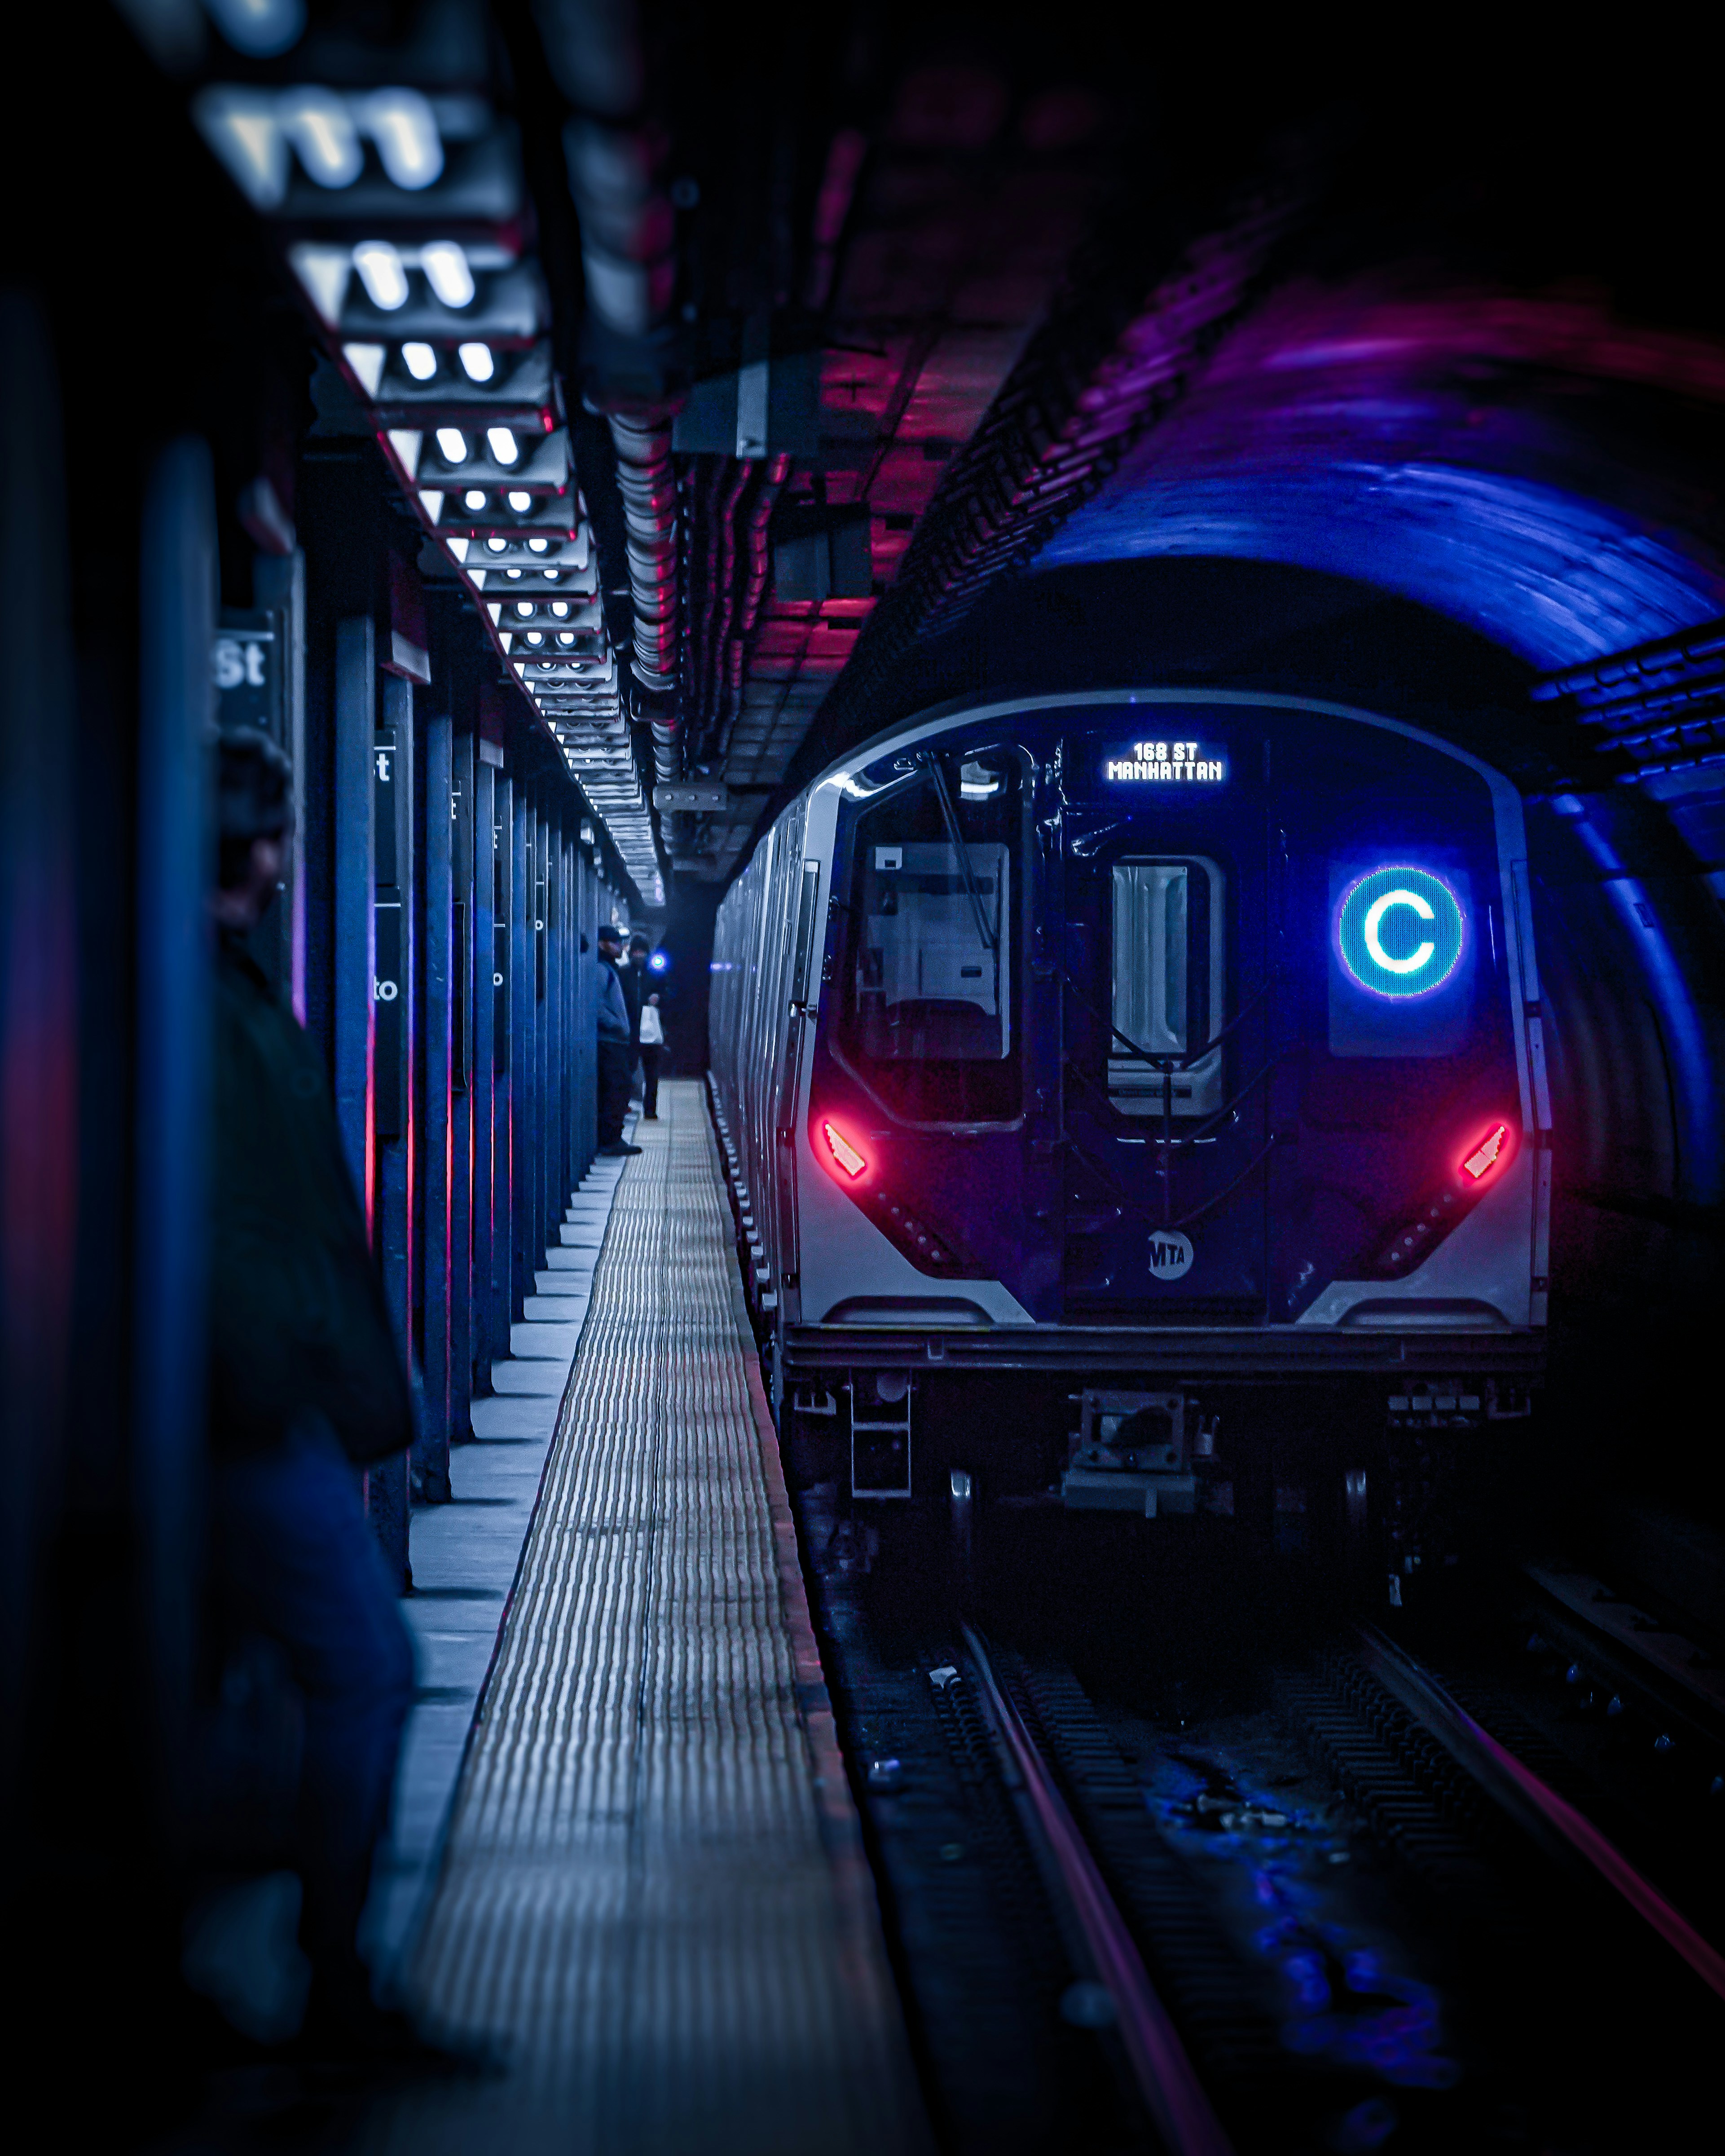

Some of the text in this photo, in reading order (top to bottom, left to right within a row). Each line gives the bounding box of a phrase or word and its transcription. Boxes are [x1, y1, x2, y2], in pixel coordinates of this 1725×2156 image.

[215, 639, 266, 688] St
[1135, 742, 1197, 760] 168 ST
[1108, 761, 1222, 780] MANHATTAN
[1364, 889, 1435, 973] C
[1148, 1240, 1185, 1268] MTA
